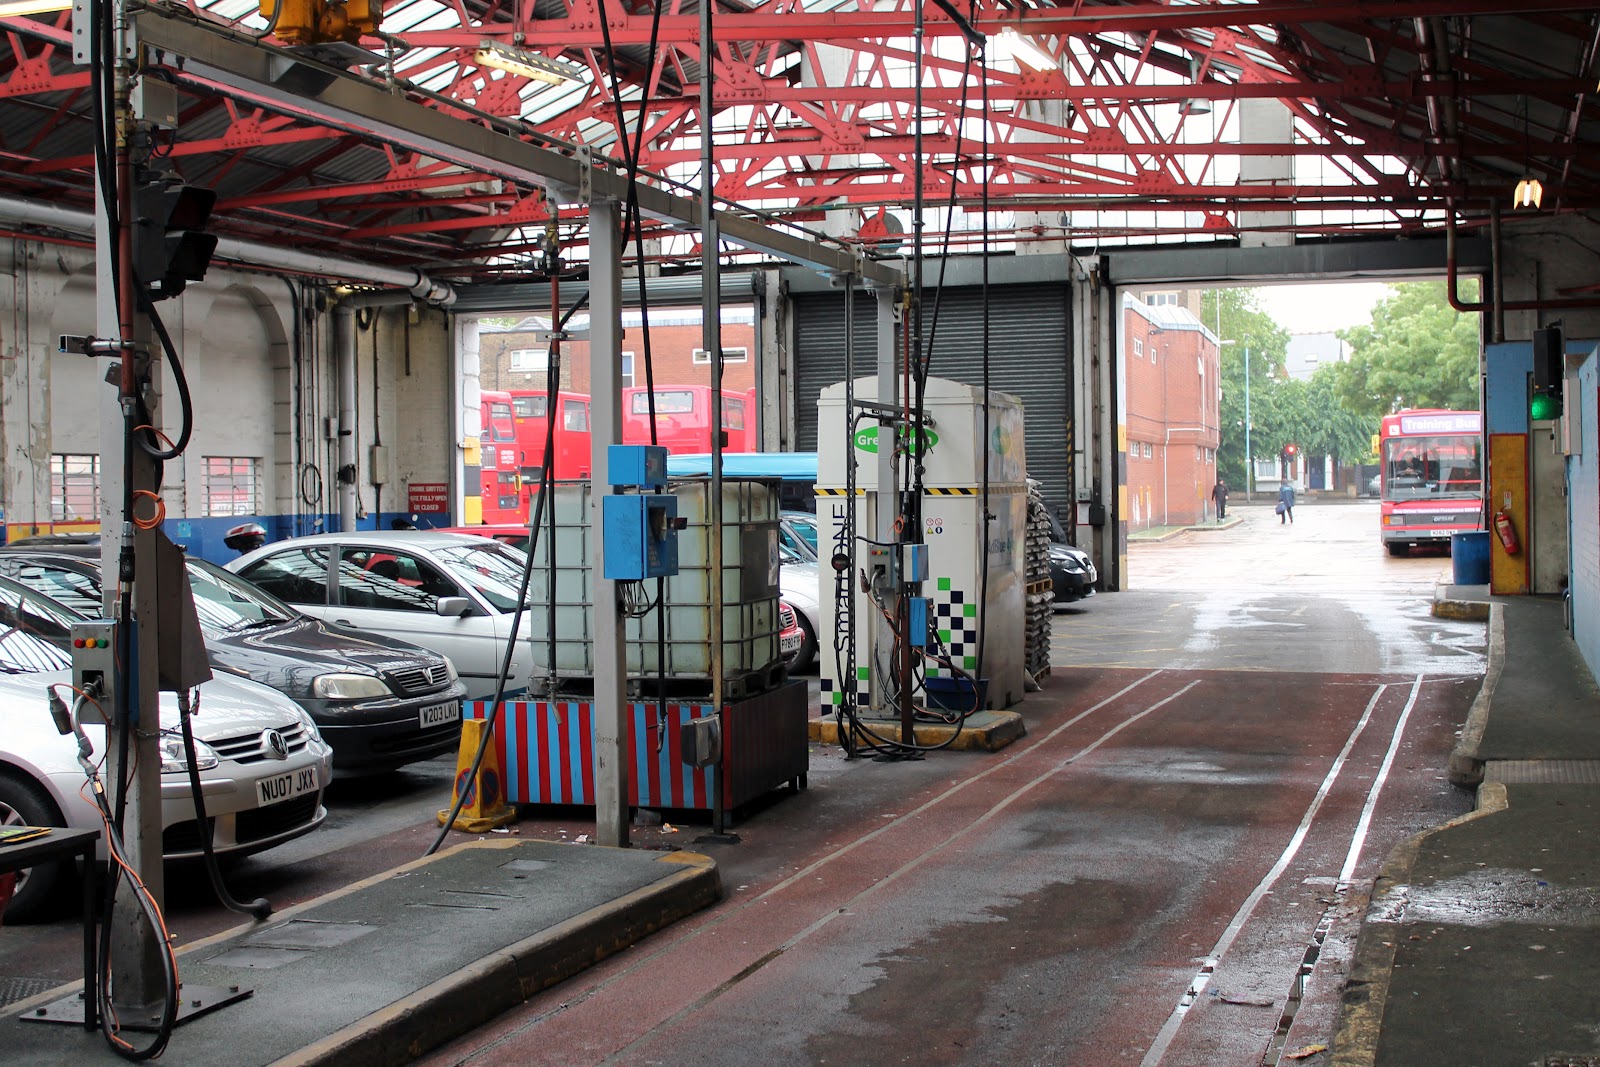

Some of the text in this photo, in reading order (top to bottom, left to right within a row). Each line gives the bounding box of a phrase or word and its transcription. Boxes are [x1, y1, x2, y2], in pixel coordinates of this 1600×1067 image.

[1404, 417, 1478, 431] Training Bus
[422, 702, 457, 724] W203 LKU
[261, 768, 315, 802] NU07 JXX
